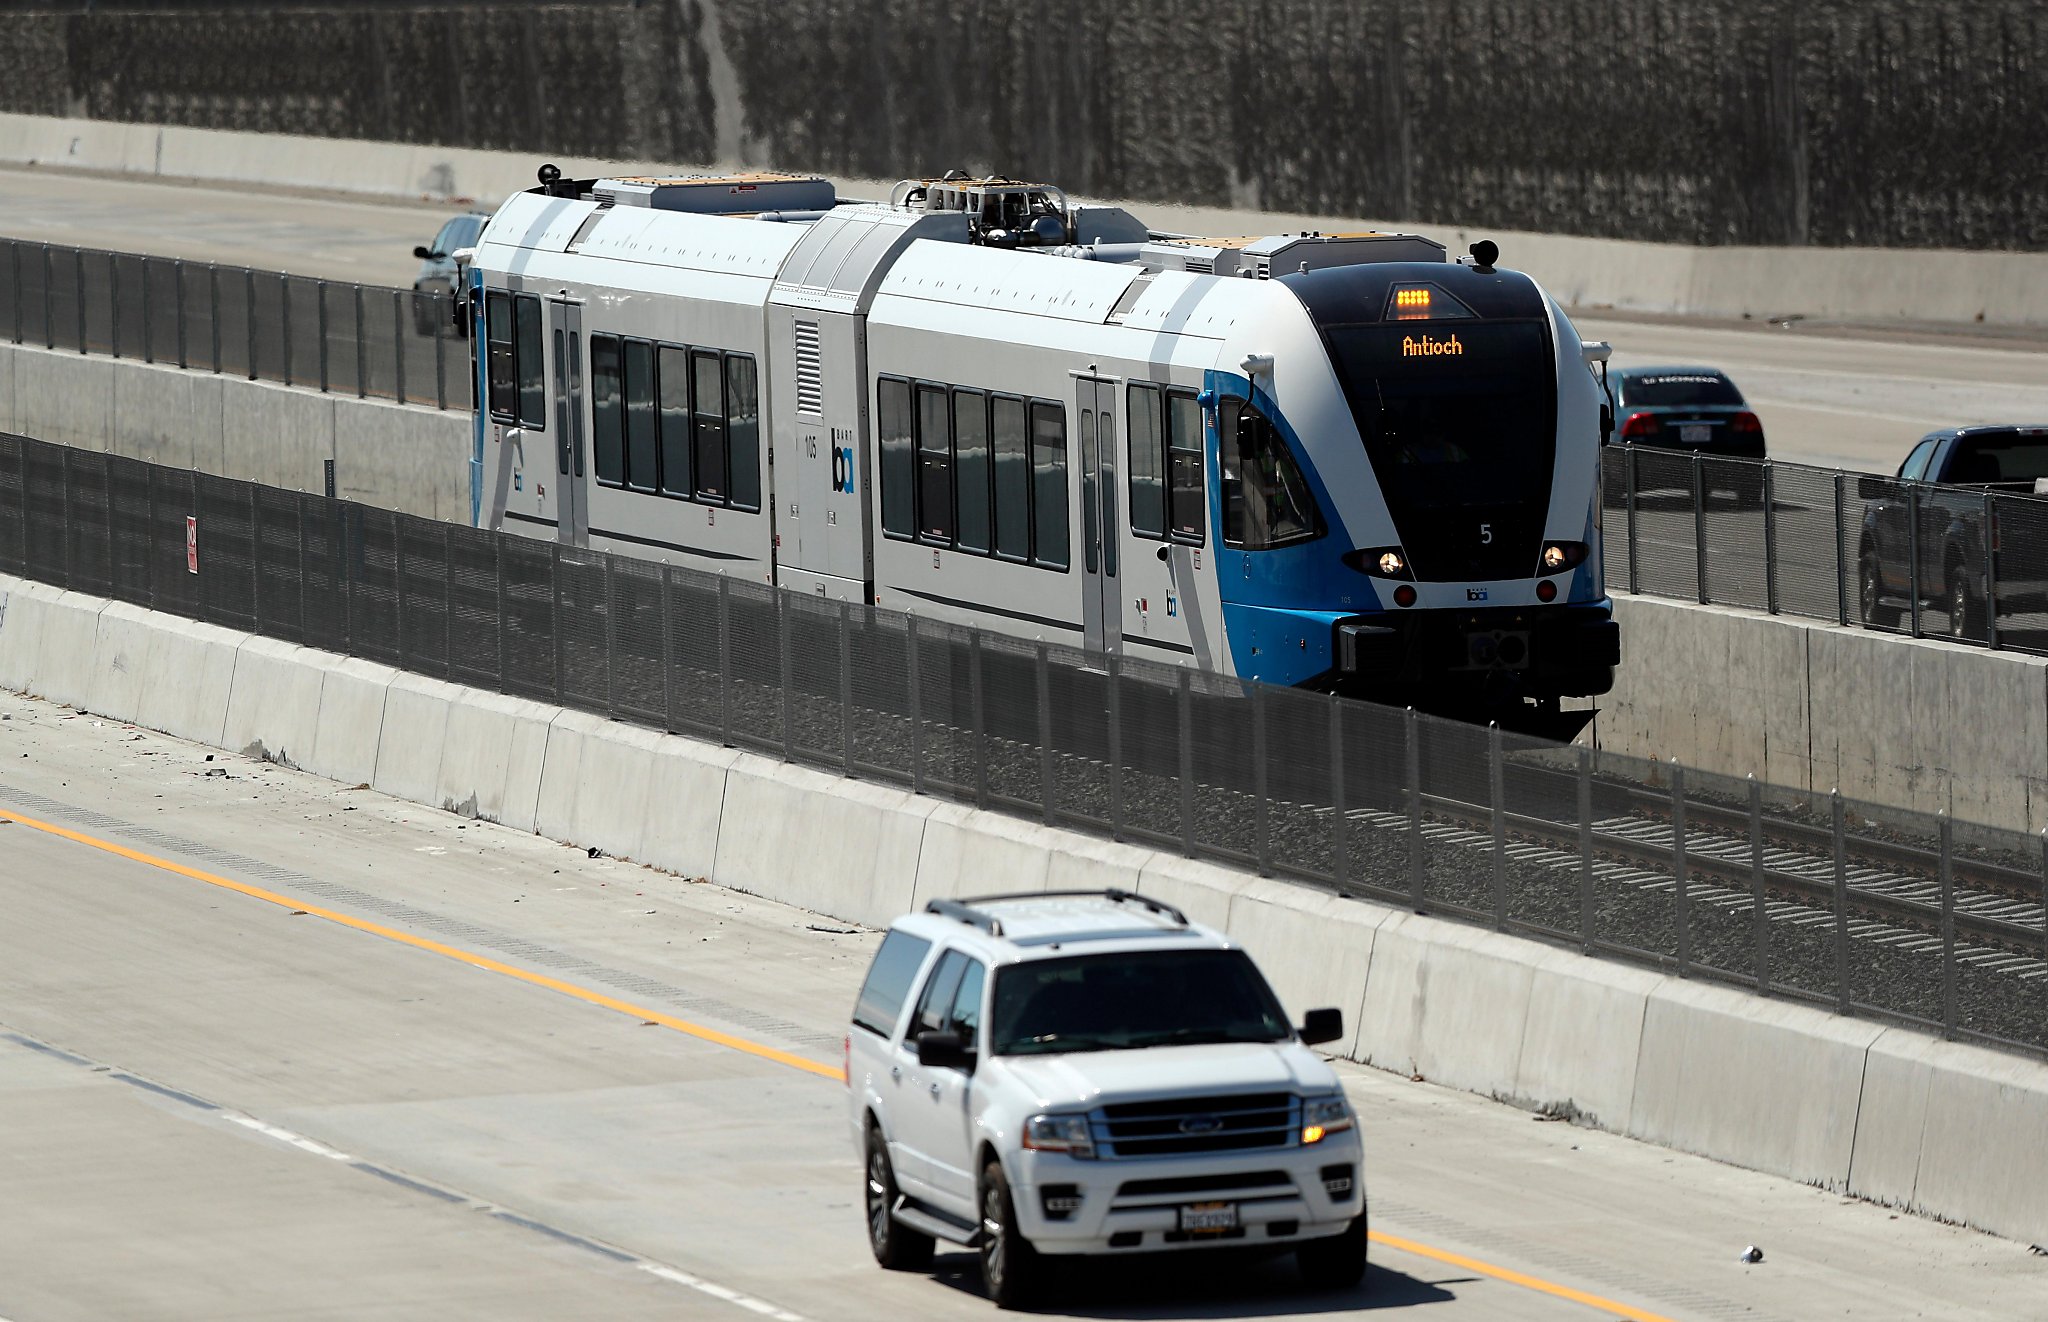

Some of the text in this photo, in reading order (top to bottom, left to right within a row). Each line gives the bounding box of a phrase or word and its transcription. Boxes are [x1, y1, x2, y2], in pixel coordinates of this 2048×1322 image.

[1403, 334, 1462, 356] Antioch
[836, 429, 852, 441] BART
[805, 435, 817, 459] 105
[1480, 524, 1492, 544] 5
